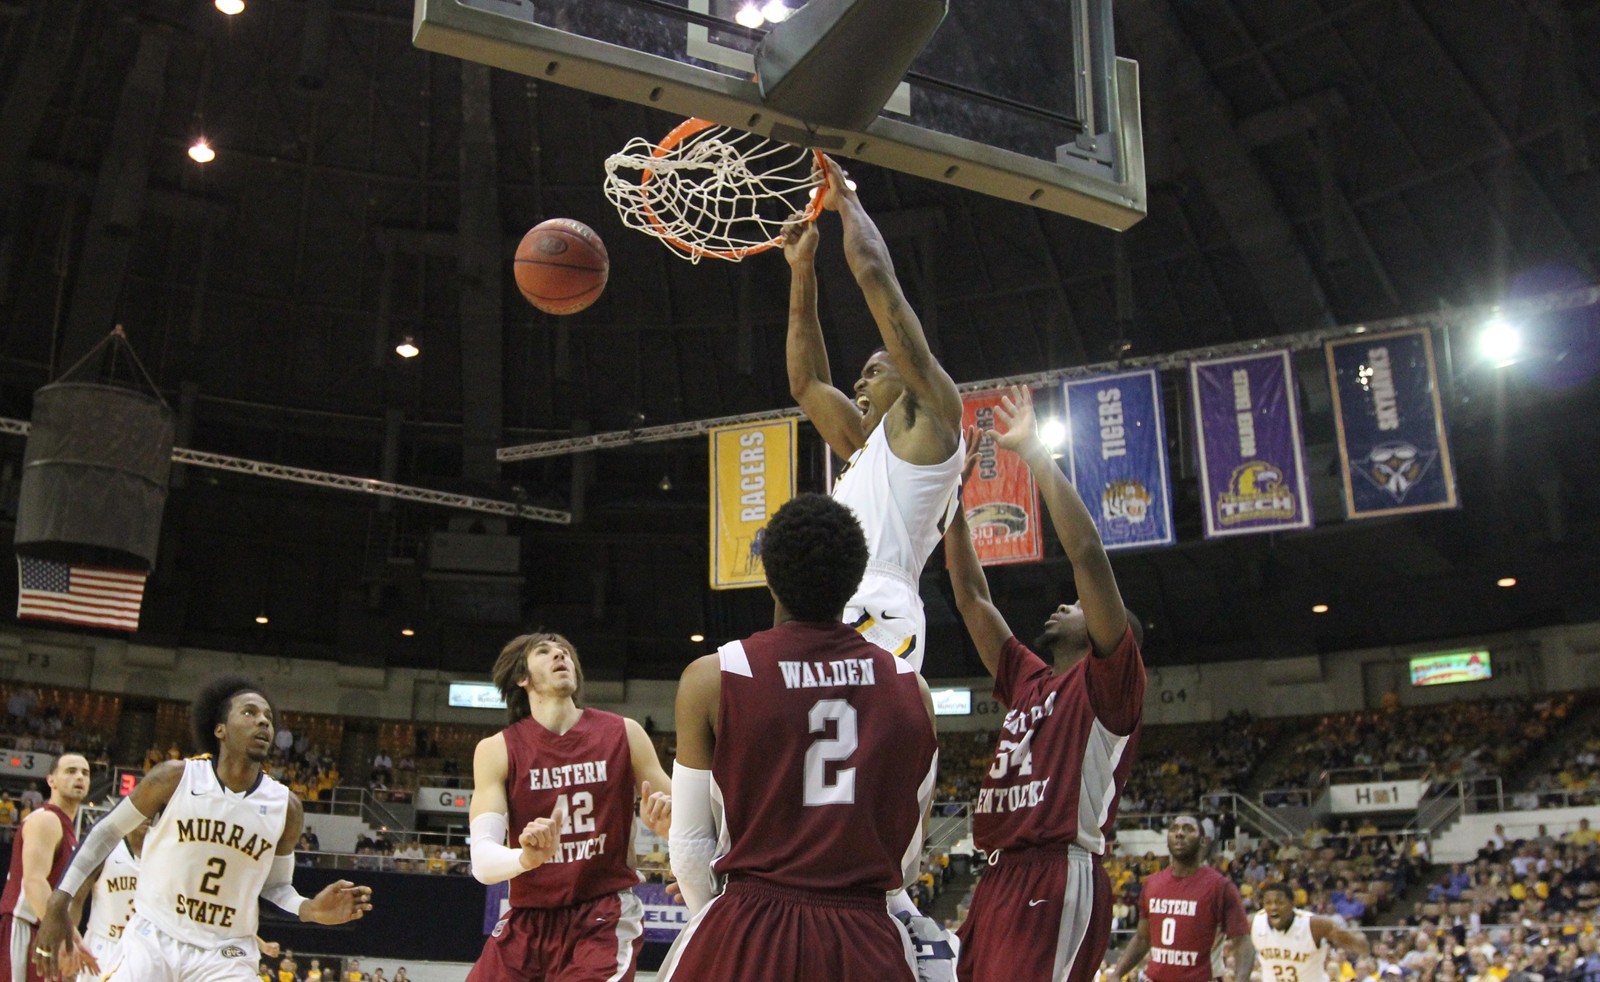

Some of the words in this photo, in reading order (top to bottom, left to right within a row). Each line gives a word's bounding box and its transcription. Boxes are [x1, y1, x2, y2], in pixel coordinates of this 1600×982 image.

[976, 406, 998, 481] COUGRS
[1097, 387, 1127, 461] TIGERS
[739, 431, 766, 523] RACERS
[778, 658, 876, 689] WALDEN
[803, 698, 858, 807] 2
[529, 760, 608, 791] EASTERN
[553, 791, 596, 835] 42
[177, 818, 273, 862] MURRAY
[106, 876, 138, 893] MUR
[199, 856, 227, 896] 2
[175, 893, 237, 928] STATE
[1148, 898, 1198, 917] EASTERN
